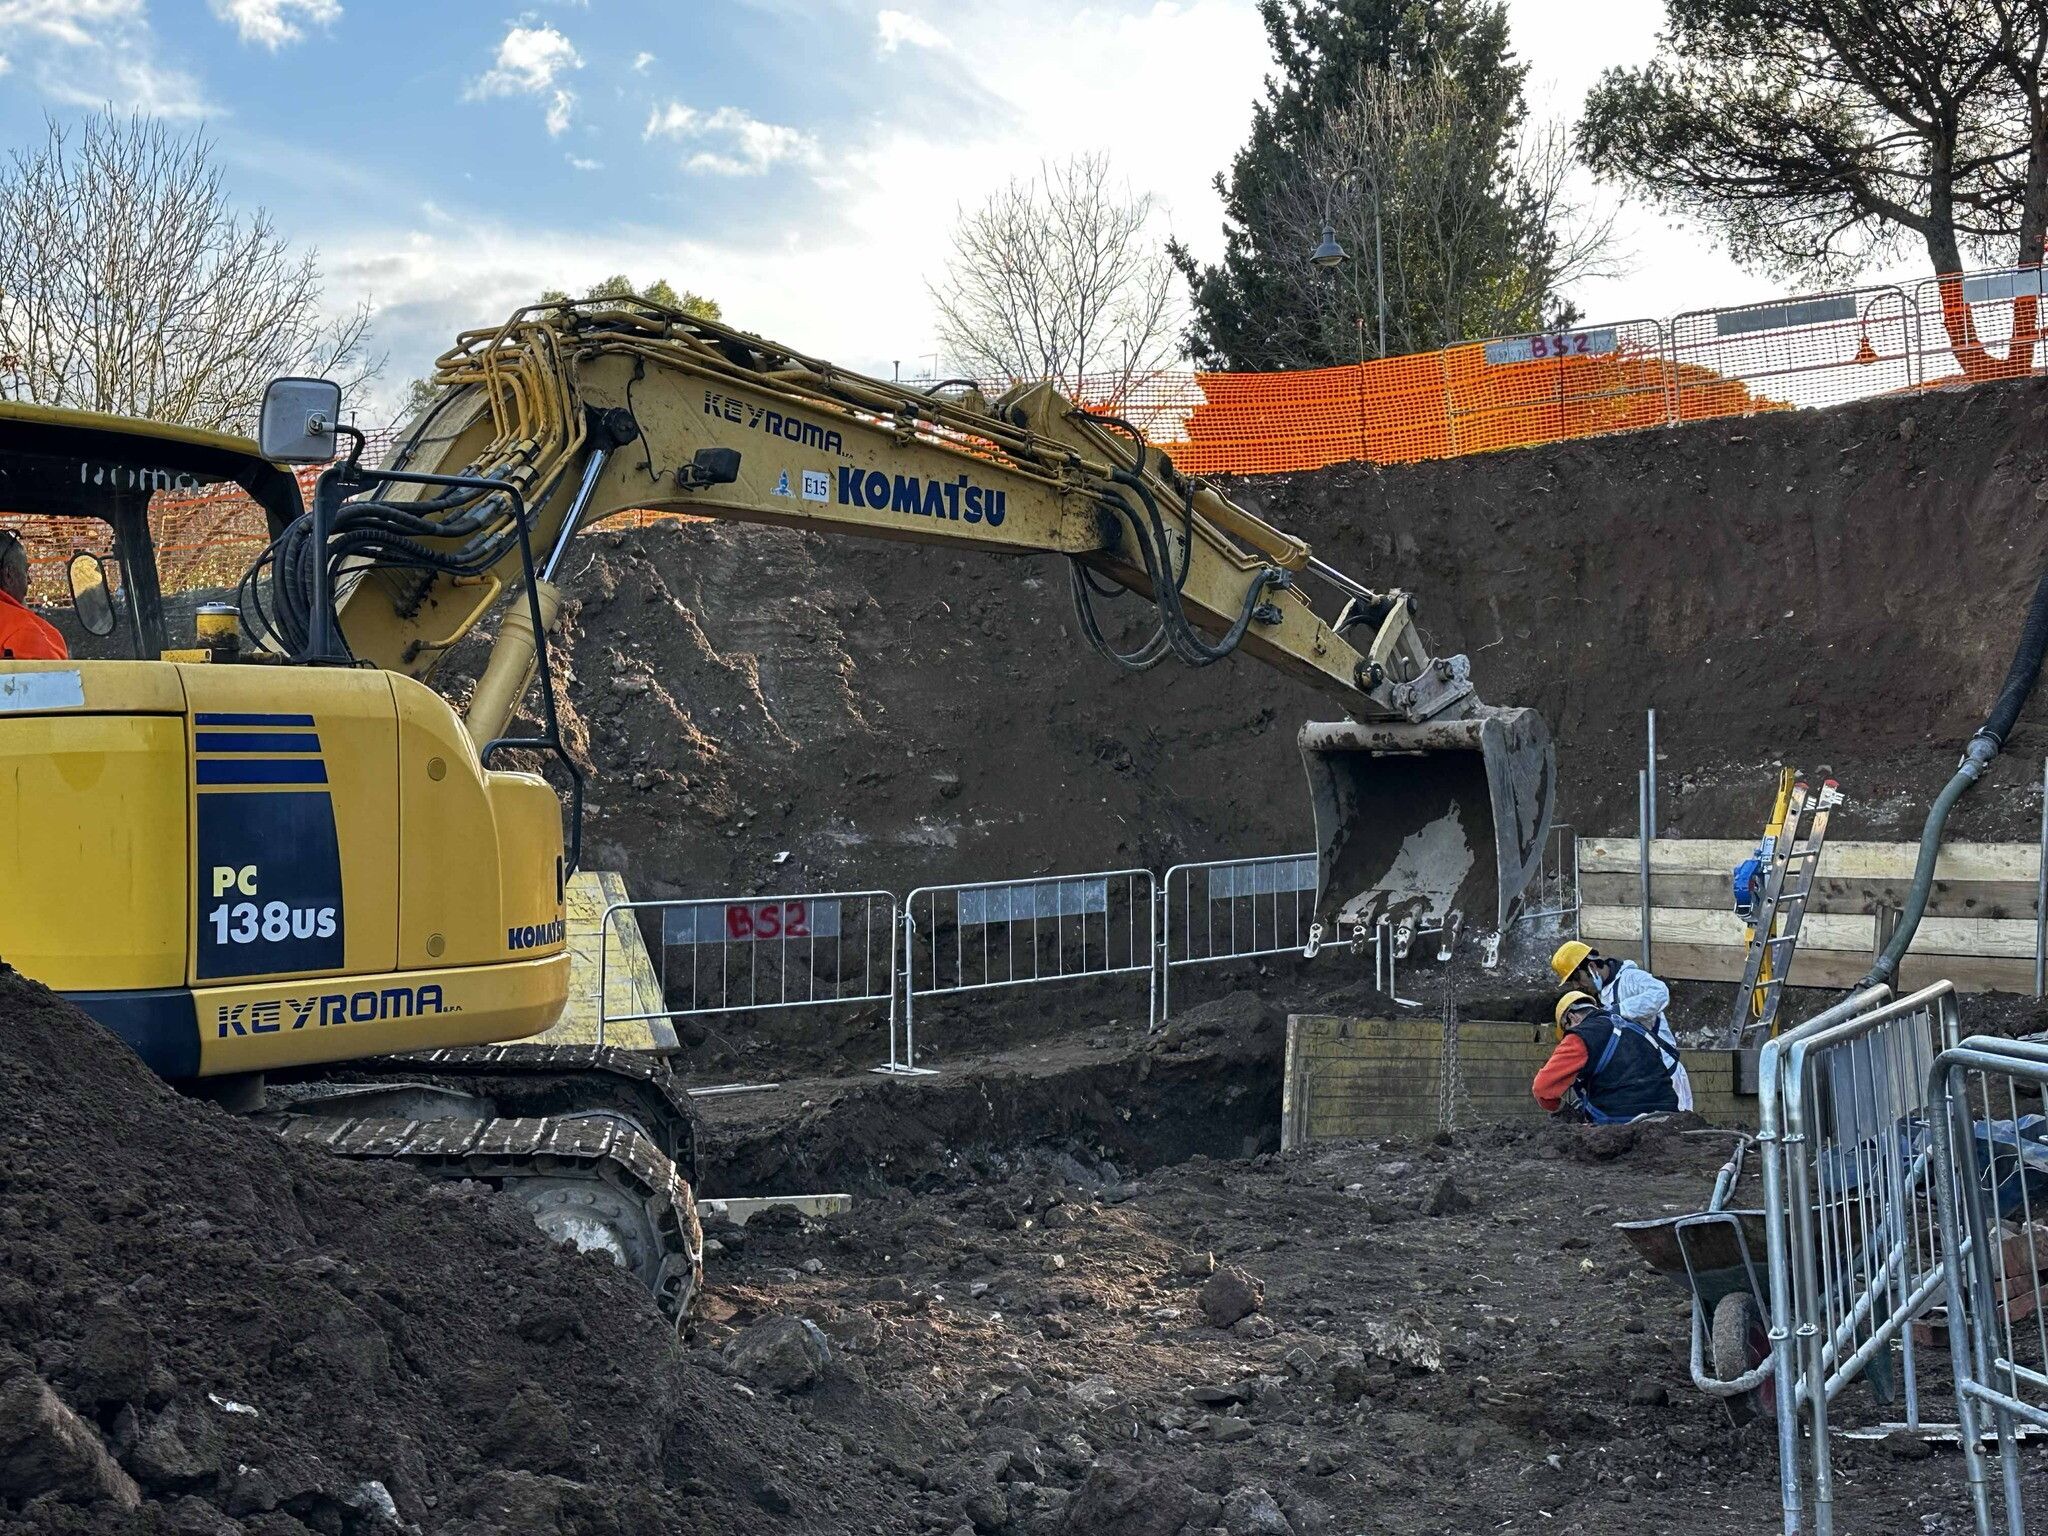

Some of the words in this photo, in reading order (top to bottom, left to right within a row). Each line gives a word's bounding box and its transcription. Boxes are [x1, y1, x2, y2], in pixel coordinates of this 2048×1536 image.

[704, 390, 842, 456] KEYROMA
[804, 476, 827, 497] E15
[838, 466, 1006, 527] KOMATSU
[213, 864, 257, 897] PC
[209, 900, 337, 945] 138US
[726, 901, 811, 939] BS2
[218, 984, 443, 1038] KEYROMA
